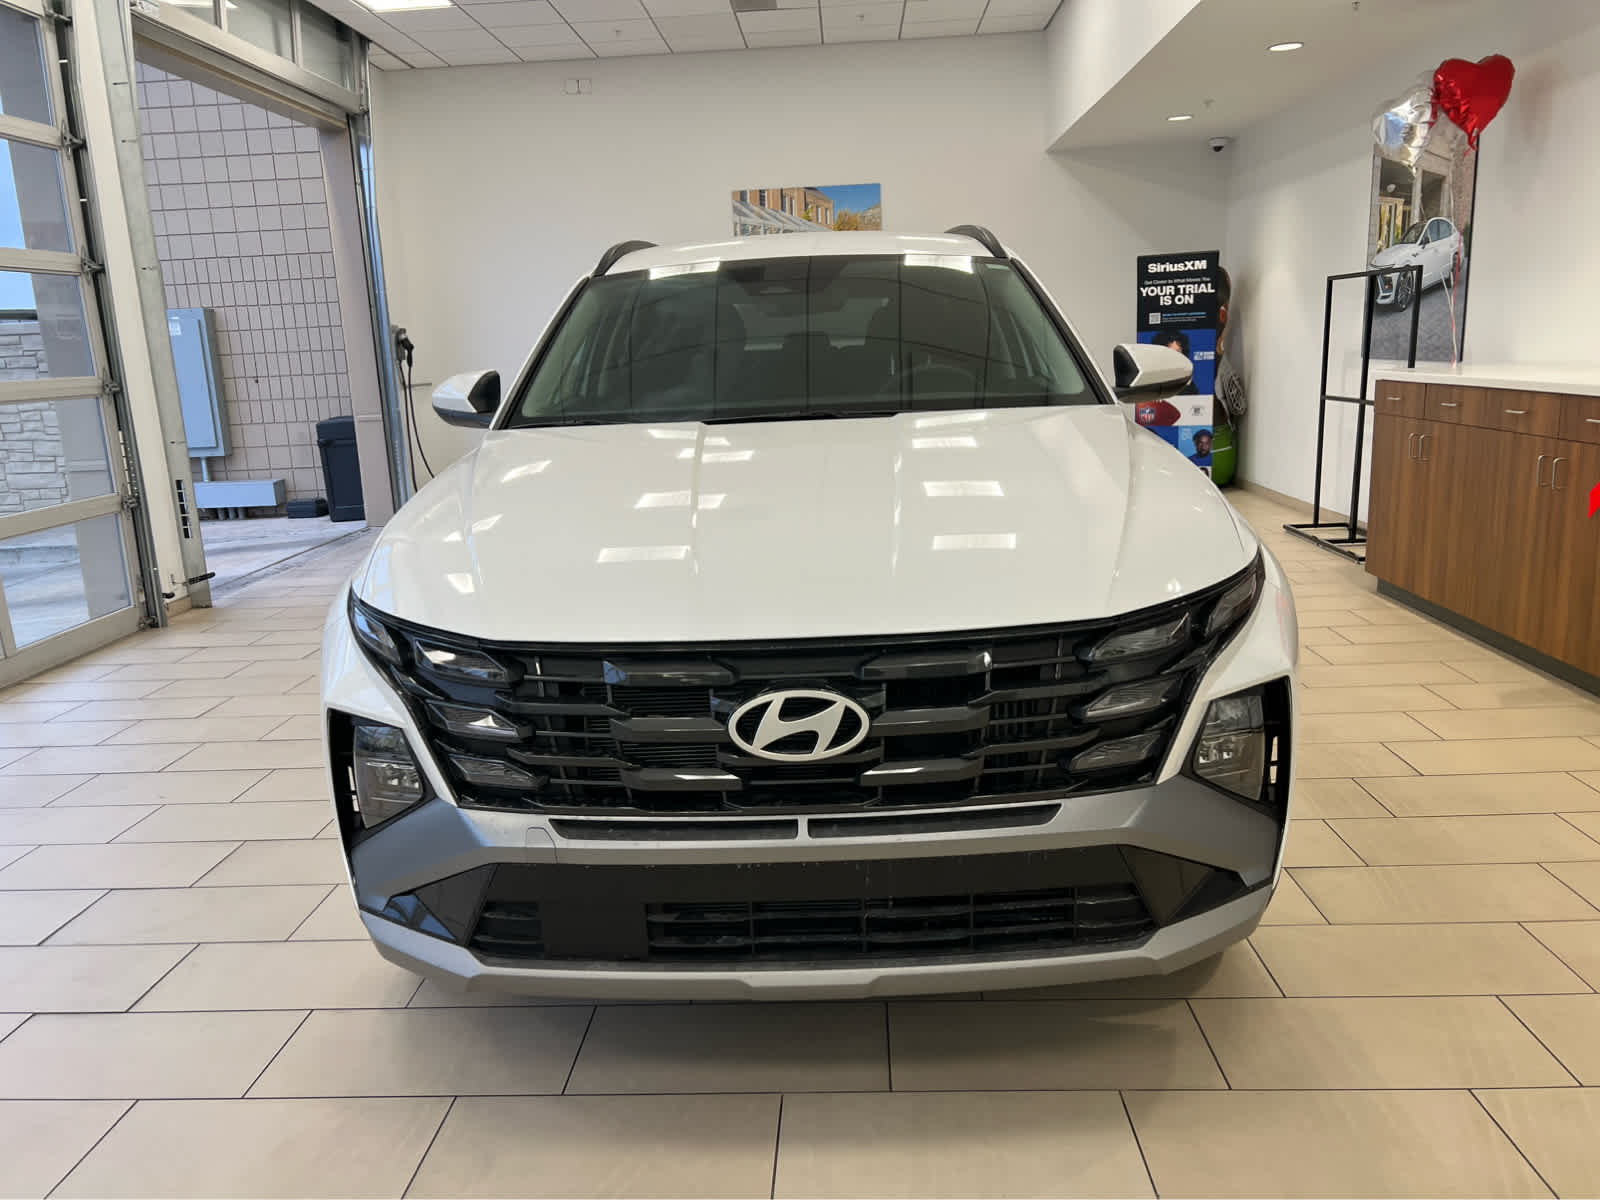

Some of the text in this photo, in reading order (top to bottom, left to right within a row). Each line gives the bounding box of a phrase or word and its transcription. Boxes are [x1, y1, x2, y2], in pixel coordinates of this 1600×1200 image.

[1147, 260, 1207, 273] SiriusXM
[1140, 283, 1215, 296] YOUR TRIAL
[1160, 294, 1194, 305] IS ON
